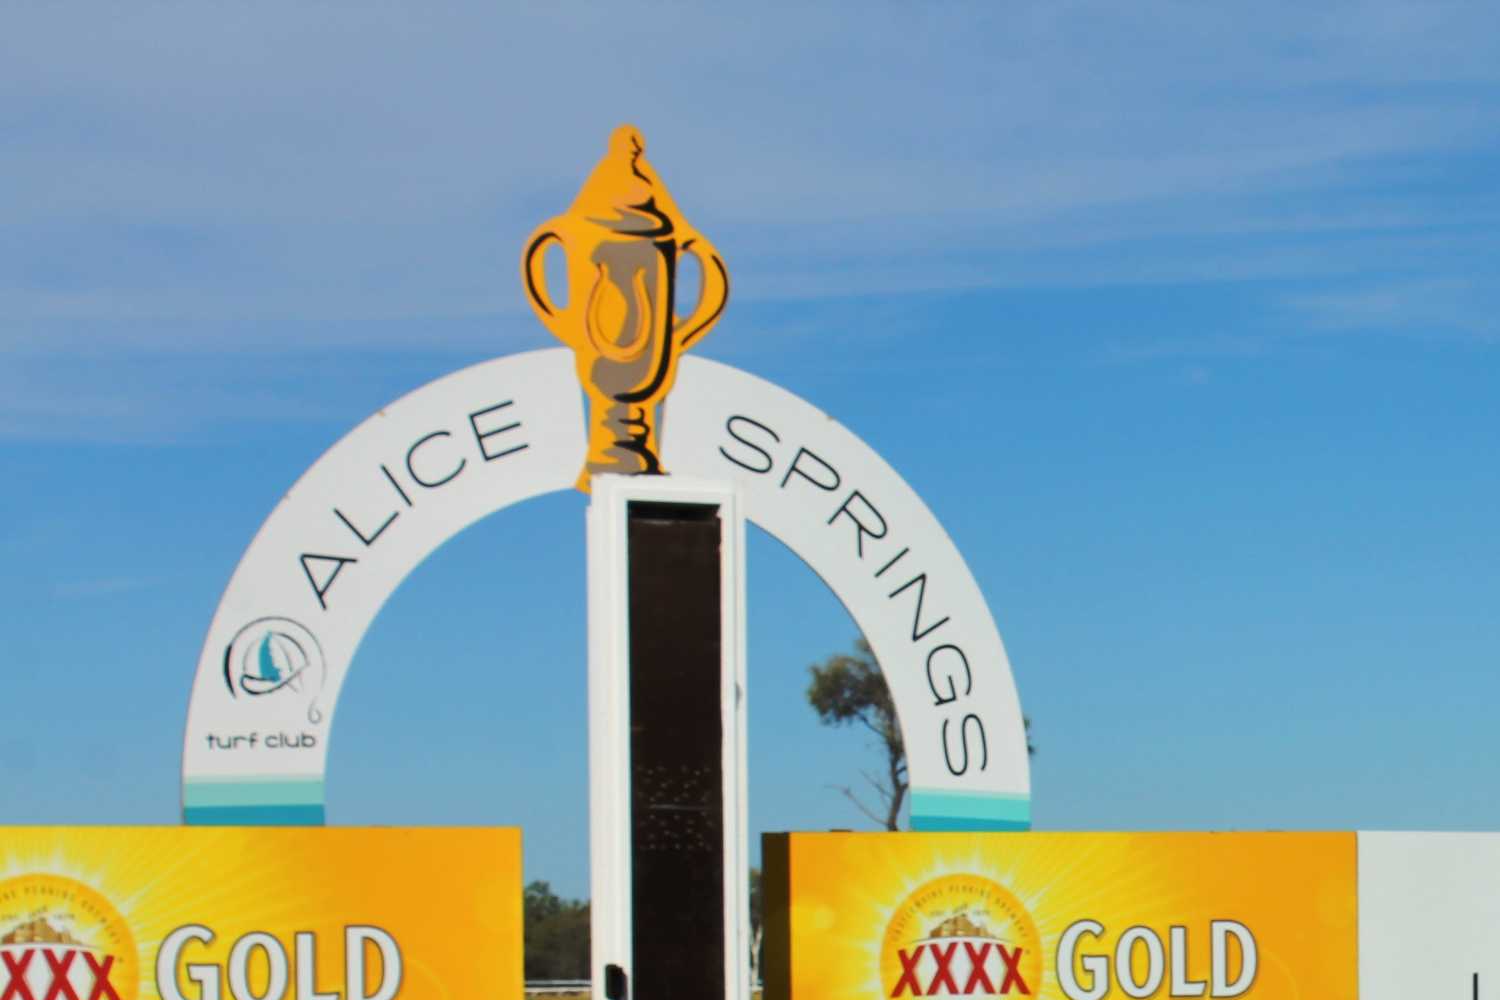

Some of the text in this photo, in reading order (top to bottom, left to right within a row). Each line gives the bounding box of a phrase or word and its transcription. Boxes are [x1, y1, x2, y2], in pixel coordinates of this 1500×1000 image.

[300, 399, 988, 777] ALICE SPRINGS
[205, 730, 317, 750] turf club
[890, 941, 1032, 998] XXXX
